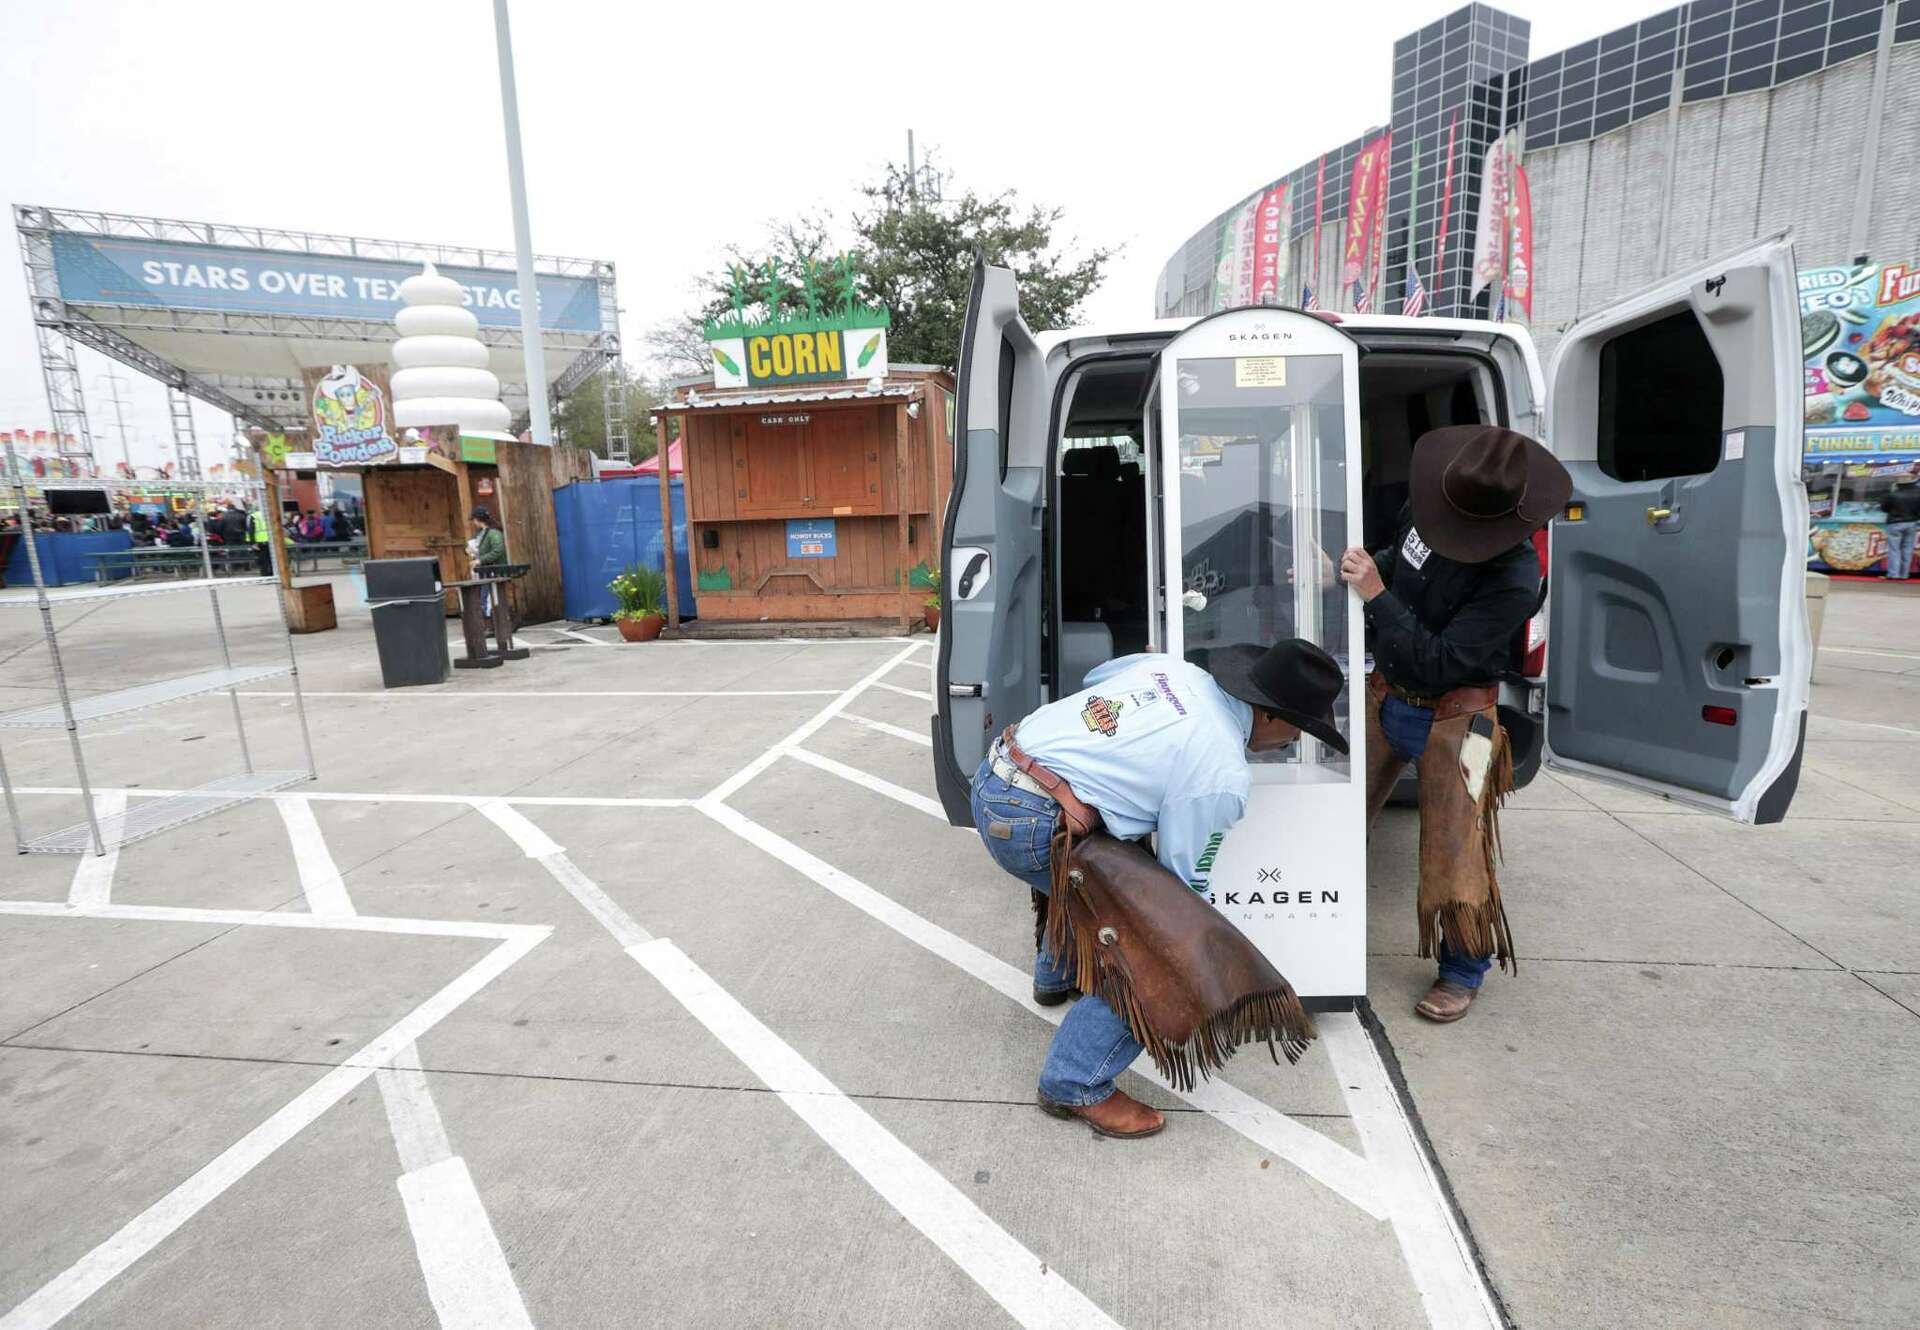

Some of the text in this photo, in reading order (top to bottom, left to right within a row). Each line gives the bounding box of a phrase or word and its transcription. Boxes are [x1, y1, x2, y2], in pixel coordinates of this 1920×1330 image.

[142, 260, 250, 291] STARS
[258, 269, 346, 298] OVER
[353, 276, 401, 302] TEX
[1798, 273, 1844, 290] RIED
[1229, 333, 1292, 341] SKAGEN
[749, 331, 842, 379] CORN
